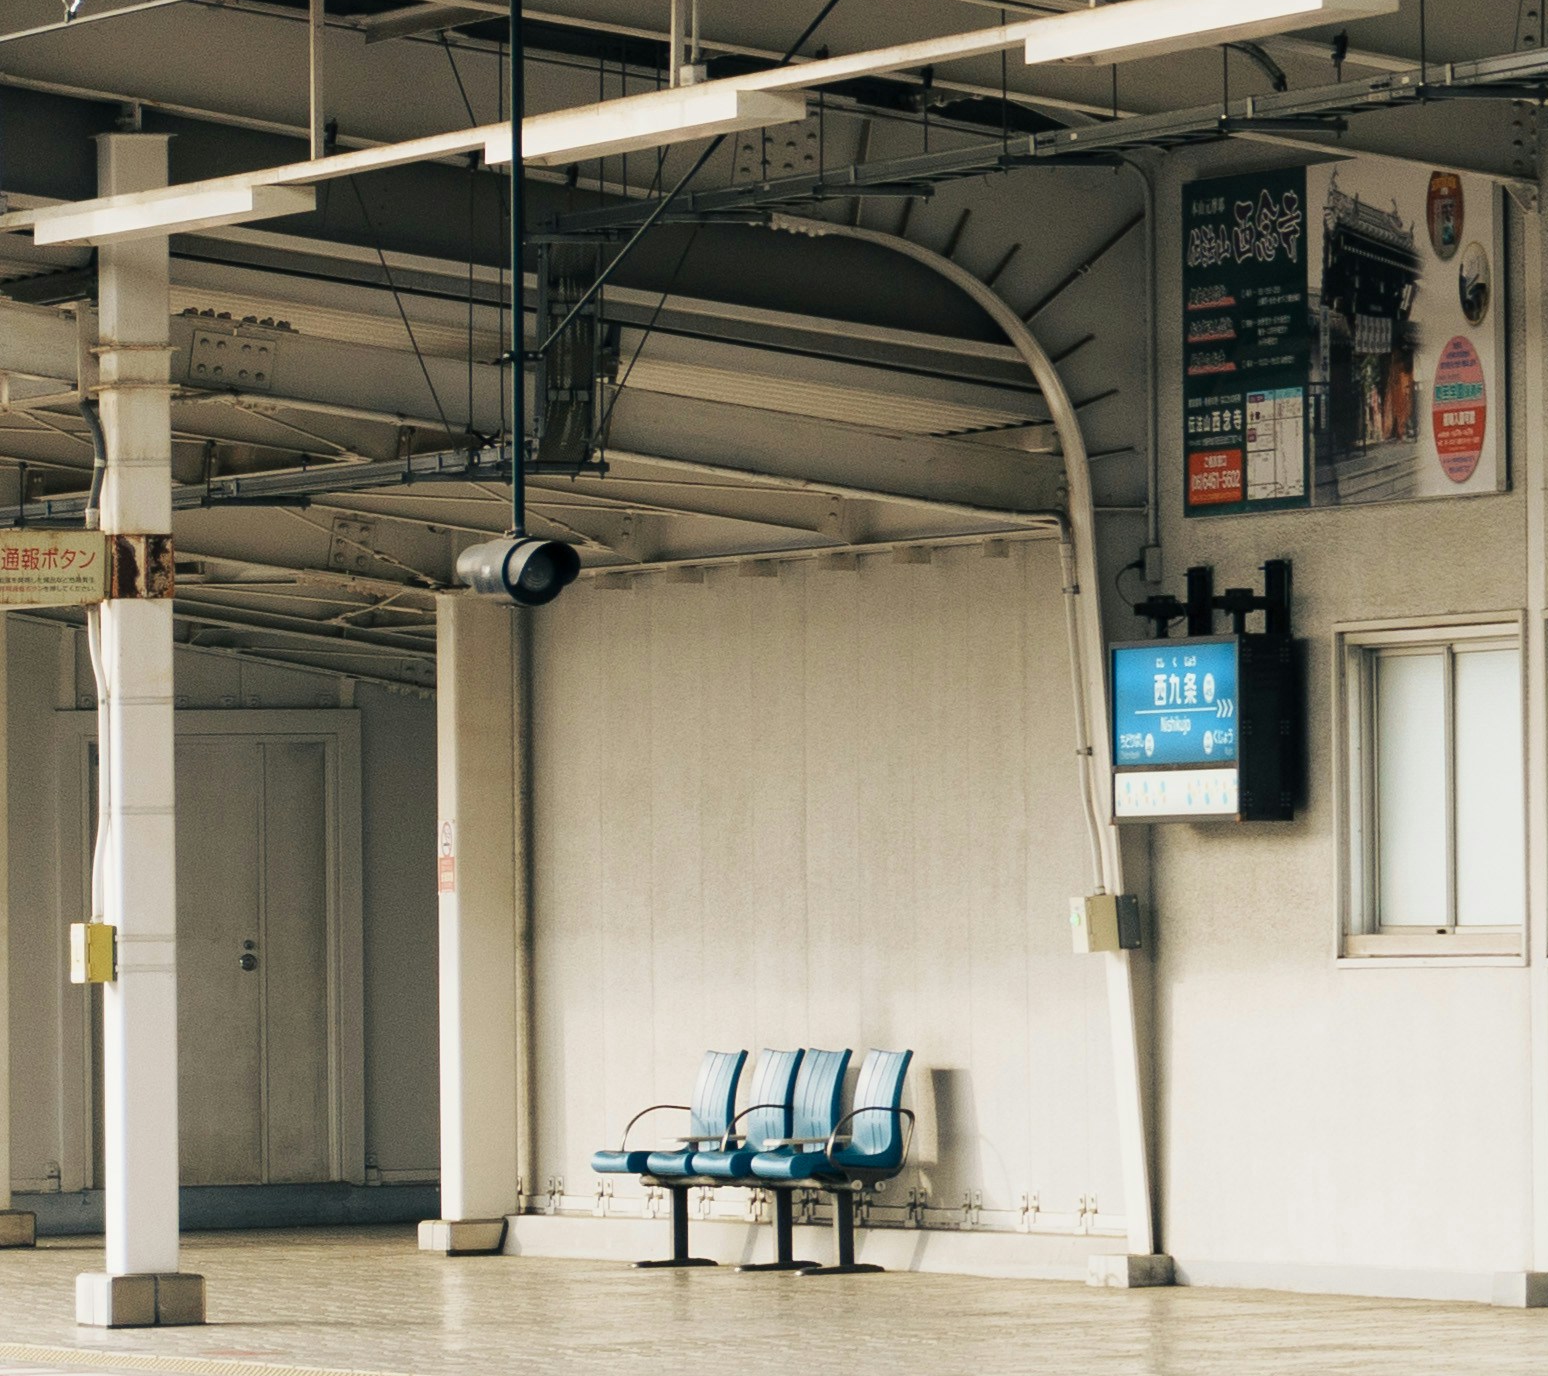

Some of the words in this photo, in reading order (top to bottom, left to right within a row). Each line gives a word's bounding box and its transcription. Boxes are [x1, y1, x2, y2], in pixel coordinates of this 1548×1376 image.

[1, 547, 97, 572] 通報ボタン
[1154, 673, 1197, 706] 西九条
